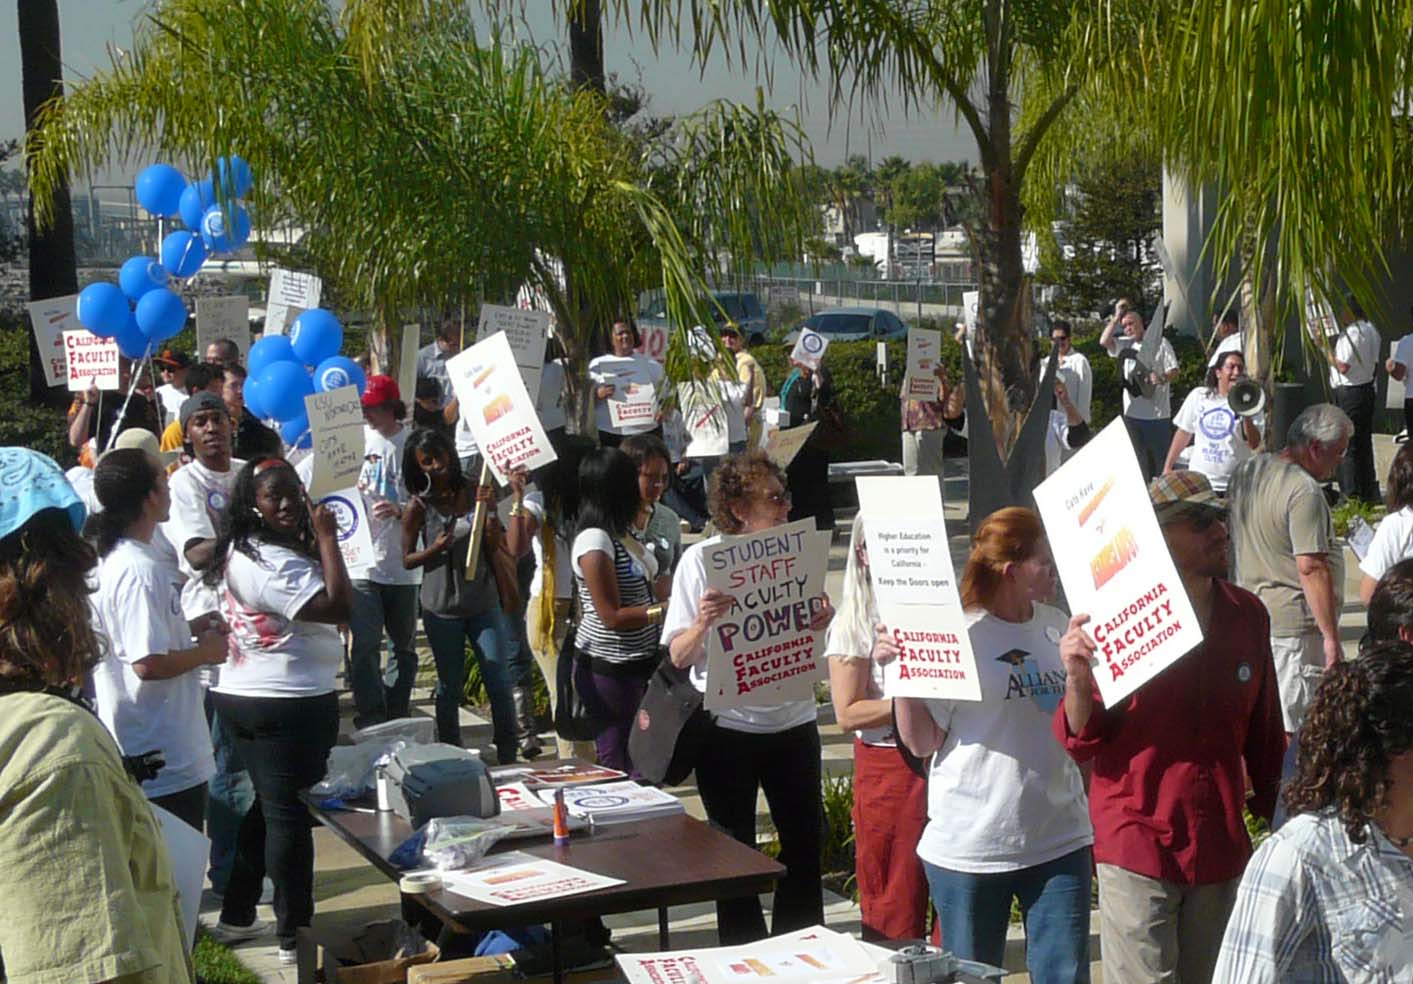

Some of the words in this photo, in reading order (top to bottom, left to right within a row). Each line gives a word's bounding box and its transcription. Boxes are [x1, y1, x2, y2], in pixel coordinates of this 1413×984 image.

[69, 350, 117, 365] FACULTY
[491, 435, 535, 465] FACULTY
[711, 530, 806, 570] STUDENT
[878, 532, 897, 542] Higher
[899, 532, 931, 540] Education
[896, 546, 919, 556] priority
[919, 546, 930, 555] for
[728, 556, 797, 589] STAFF
[891, 559, 922, 568] California
[730, 573, 808, 616] ACULTY
[878, 577, 895, 587] Keep
[896, 577, 908, 586] the
[908, 577, 929, 587] Doors
[931, 579, 950, 588] open
[1093, 582, 1168, 643] CALIFORNIA
[893, 628, 959, 645] CALIFORNIA
[1102, 598, 1174, 663] FACULTY
[733, 635, 815, 667] CALIFORNIA
[735, 647, 814, 681] FACULTY
[899, 645, 961, 664] FACULTY
[1109, 620, 1183, 682] ASSOCIATION
[737, 662, 816, 695] ASSOCIATION
[899, 664, 966, 681] ASSOCIATION
[1004, 670, 1066, 699] ALLIAN
